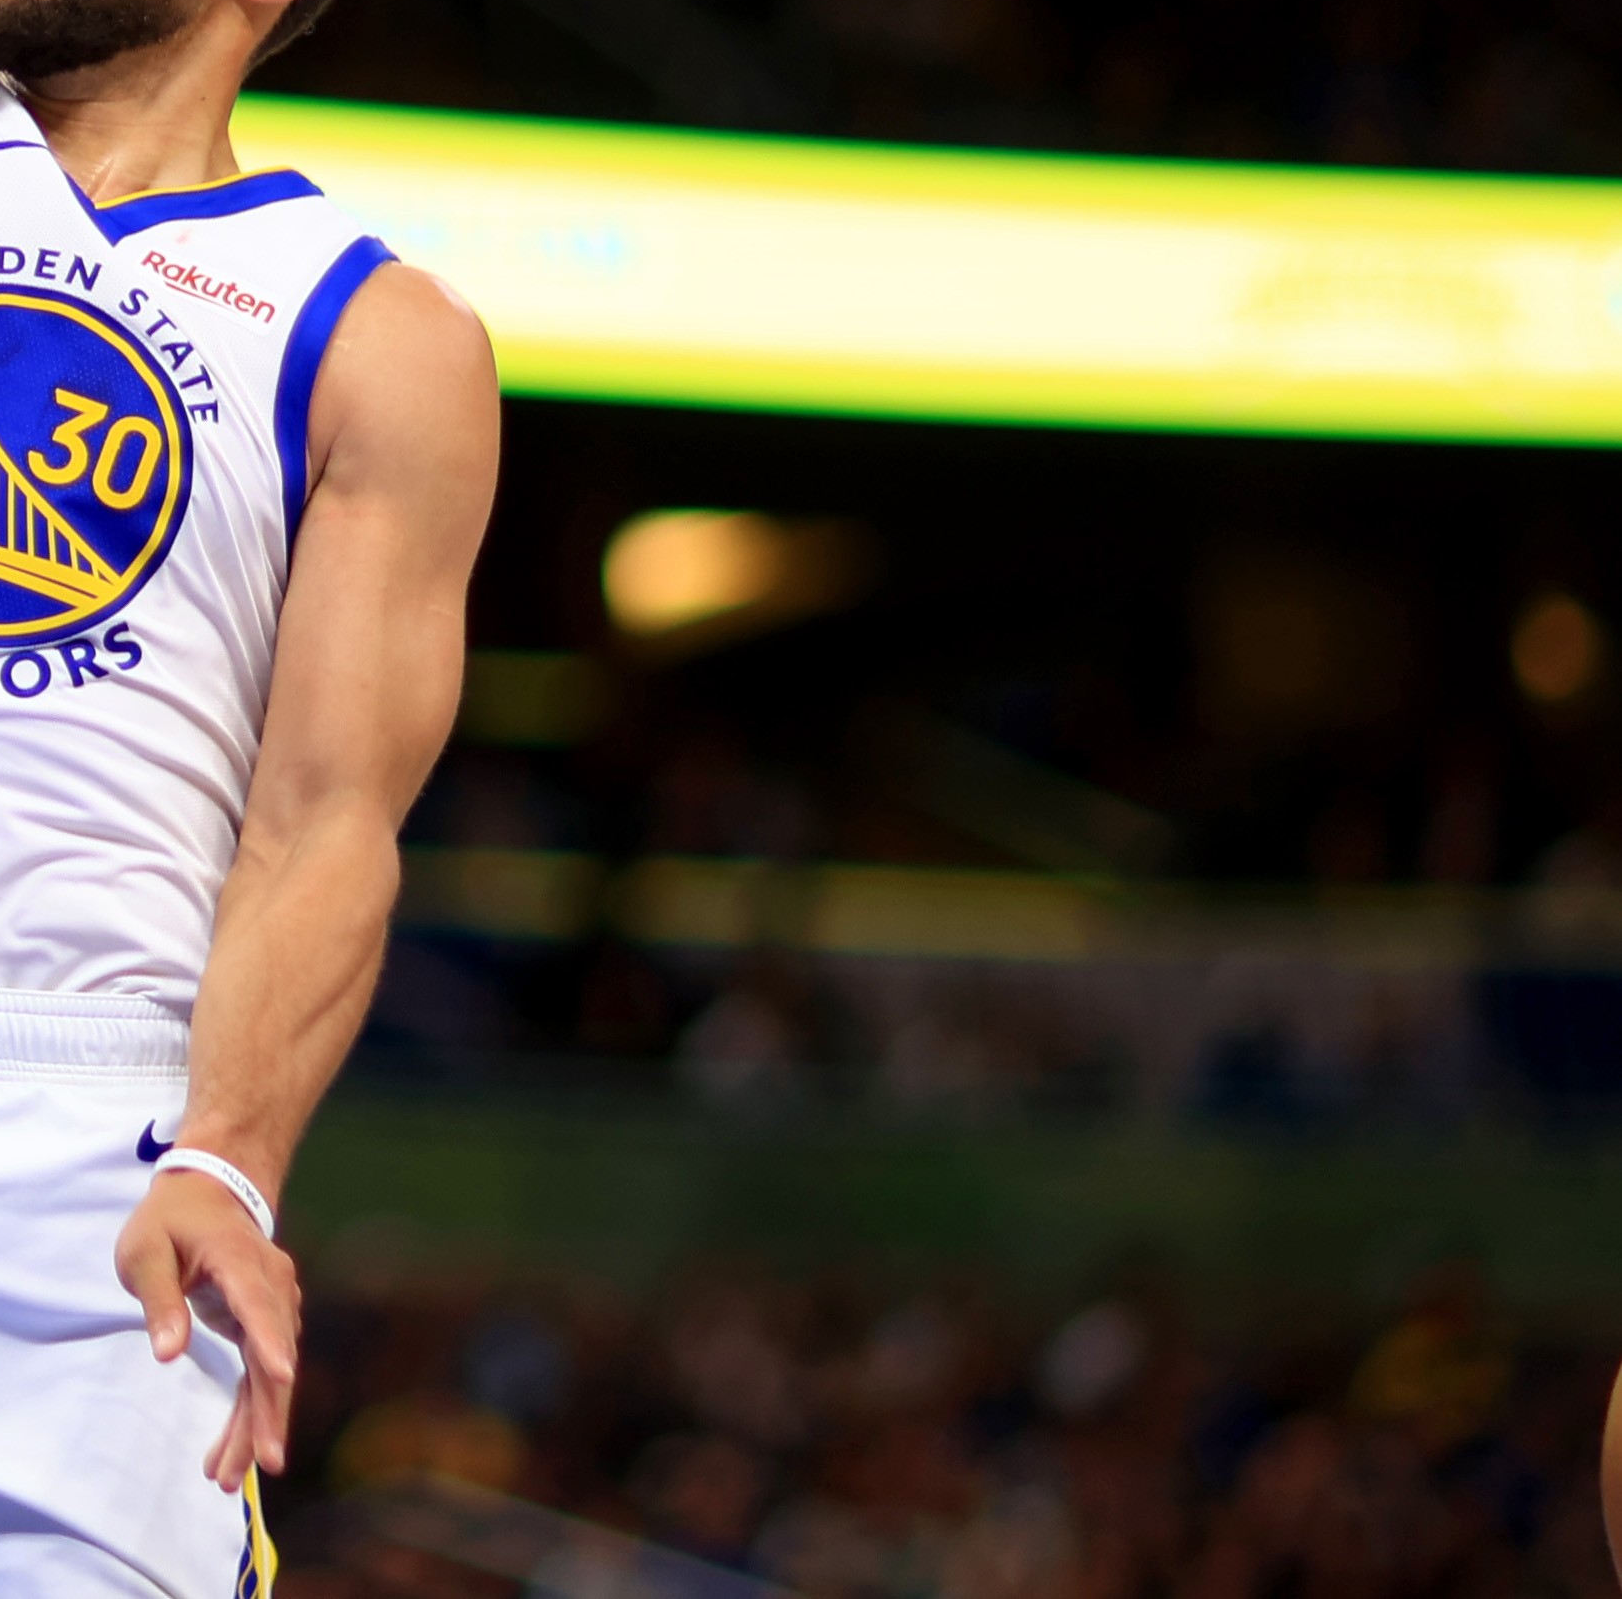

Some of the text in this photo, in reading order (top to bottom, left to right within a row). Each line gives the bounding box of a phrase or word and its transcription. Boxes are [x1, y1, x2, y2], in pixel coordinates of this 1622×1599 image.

[141, 250, 276, 324] Rakuten
[118, 287, 220, 425] STATE
[27, 386, 163, 511] 30
